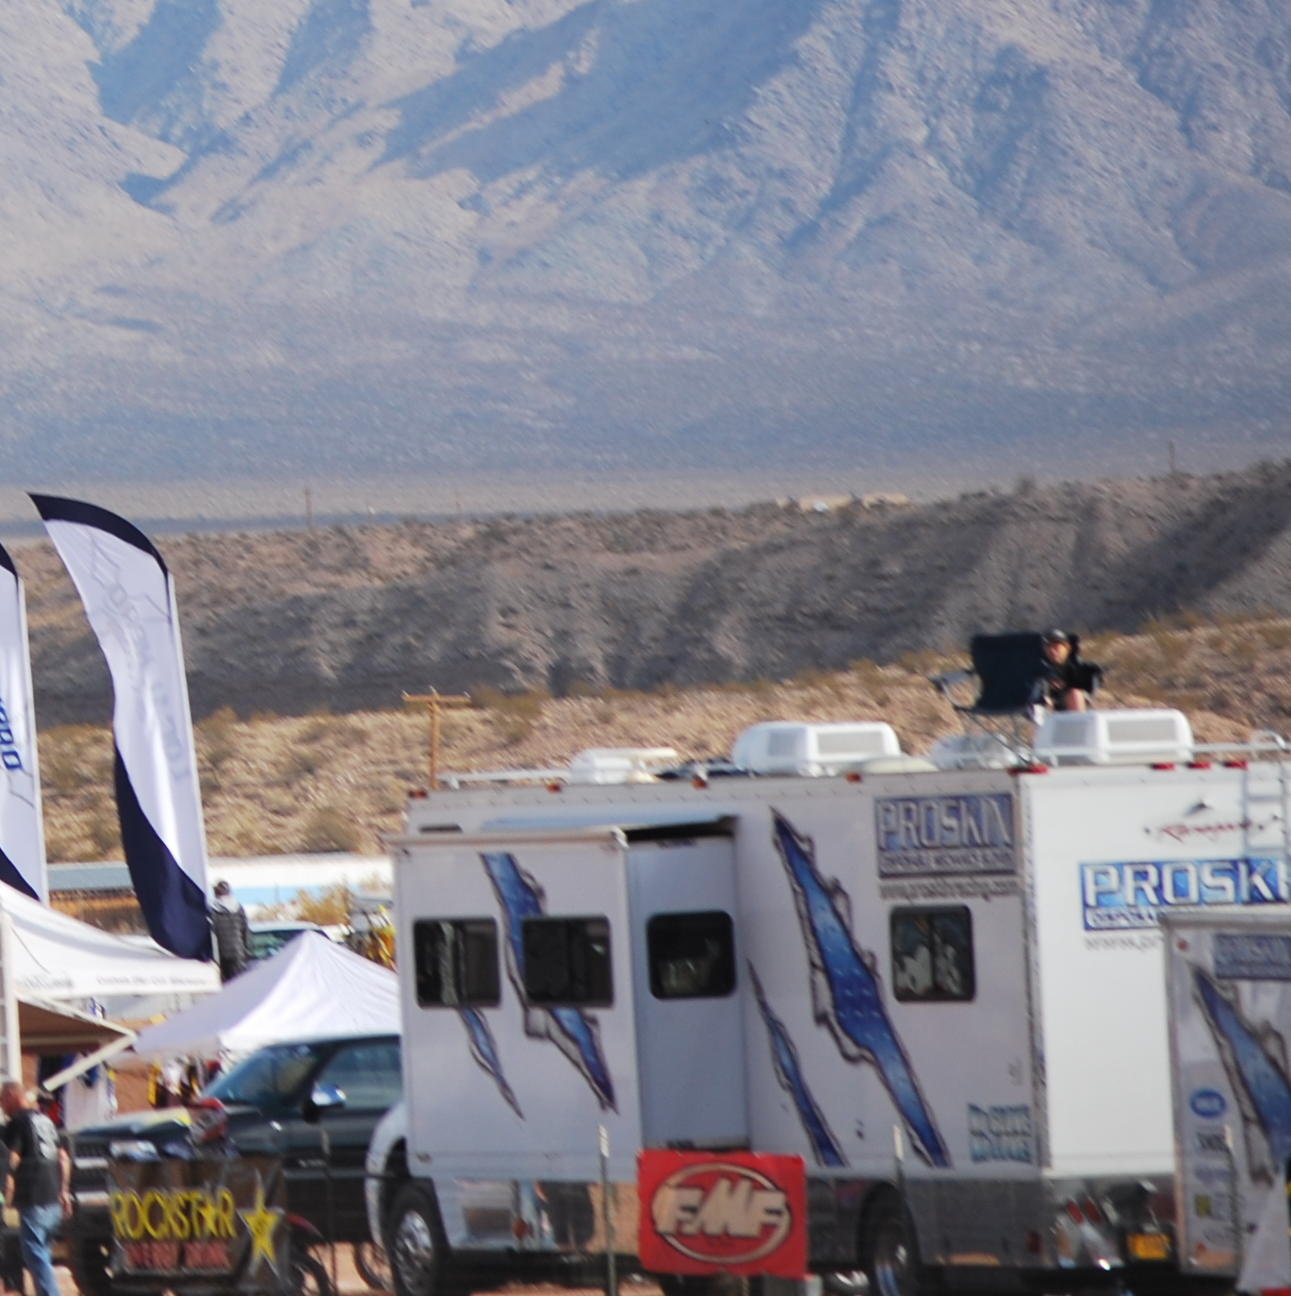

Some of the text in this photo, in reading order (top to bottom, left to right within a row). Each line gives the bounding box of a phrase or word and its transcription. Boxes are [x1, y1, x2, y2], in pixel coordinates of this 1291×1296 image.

[878, 797, 1014, 851] PROSKIN
[109, 1186, 237, 1240] ROCKSTAR
[655, 1177, 787, 1239] FMF
